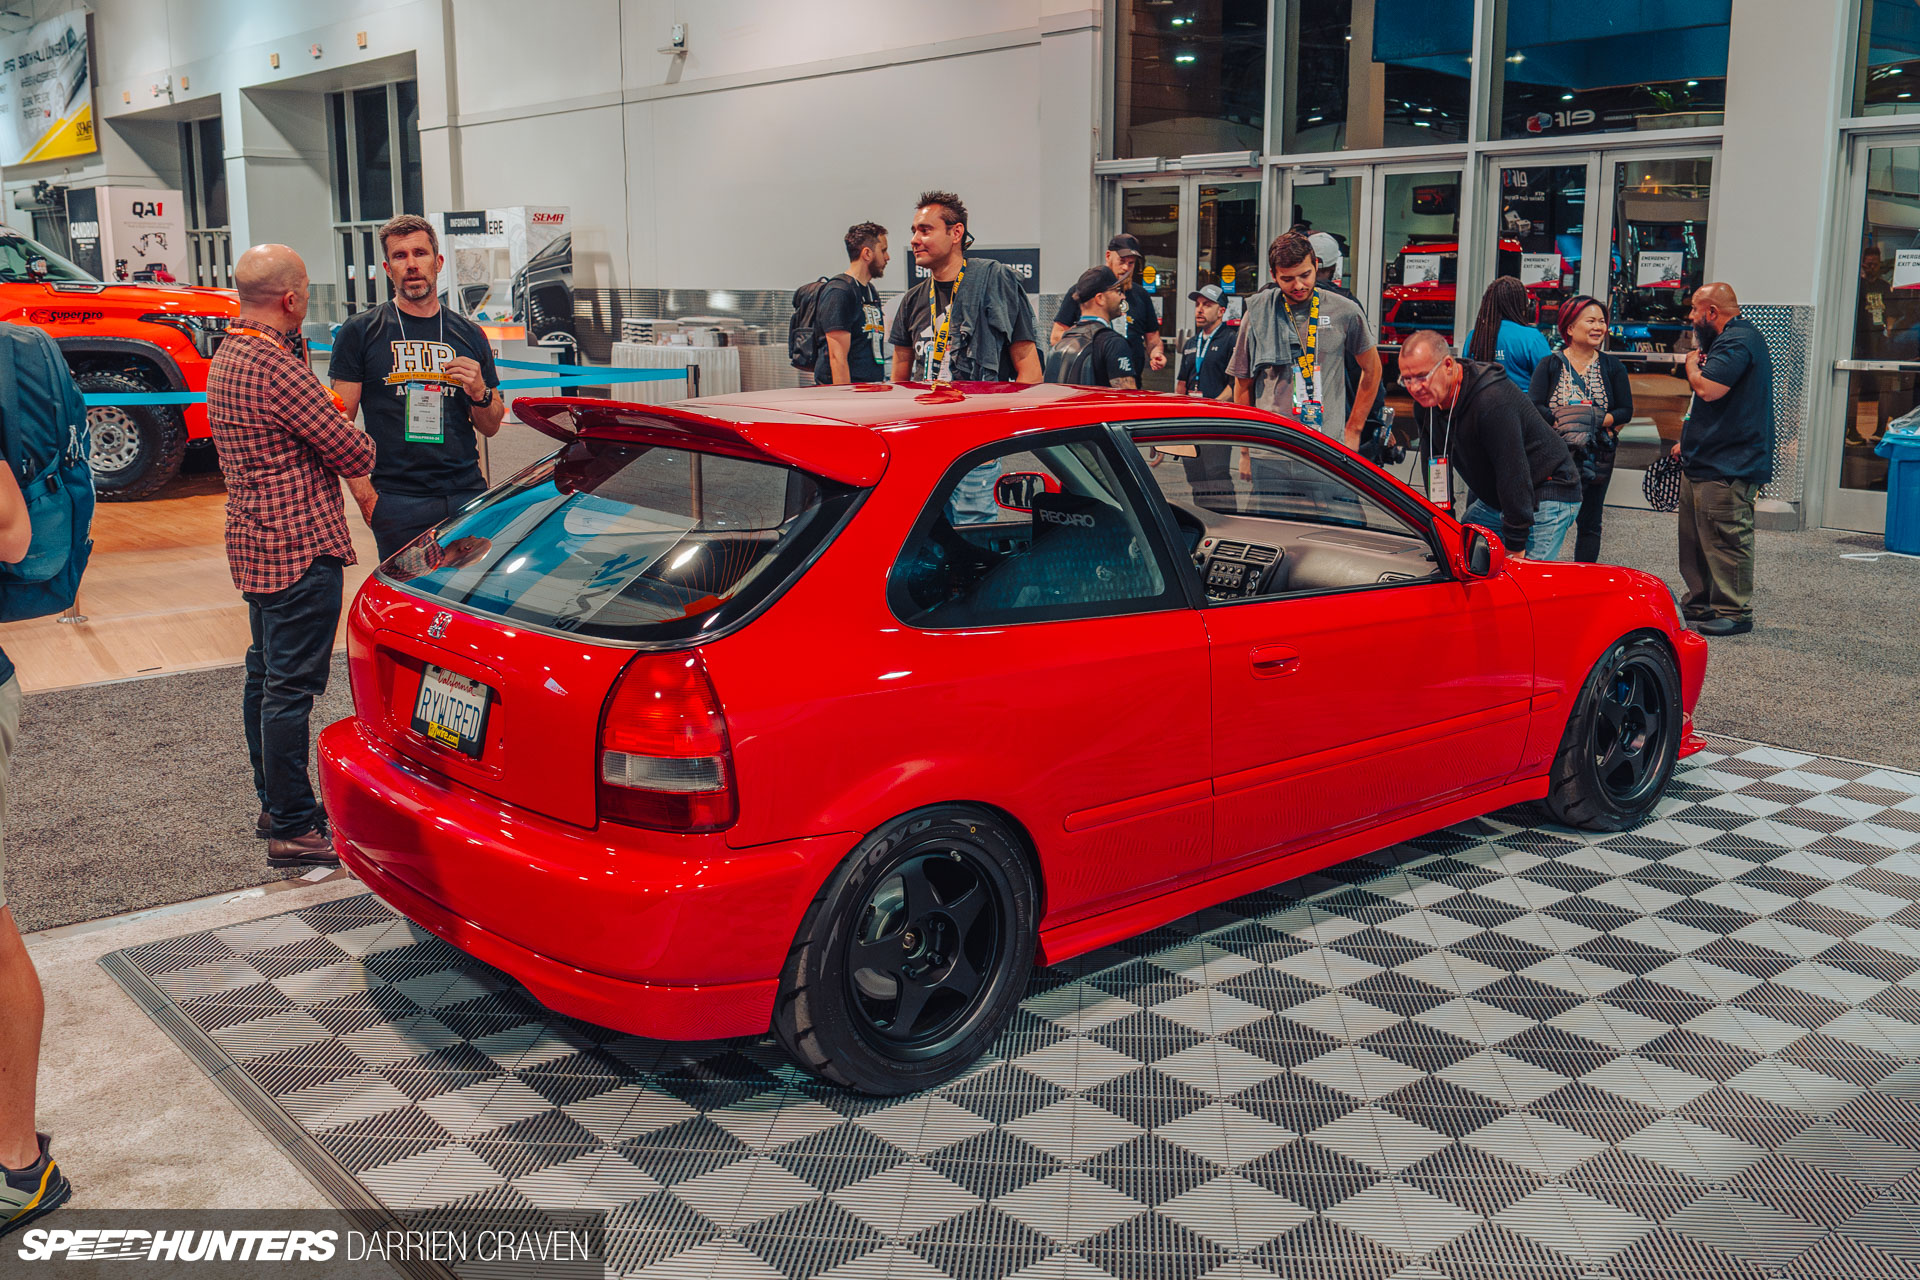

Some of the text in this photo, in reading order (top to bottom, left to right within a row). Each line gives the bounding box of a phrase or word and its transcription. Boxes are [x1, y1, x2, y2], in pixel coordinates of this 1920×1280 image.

[132, 201, 163, 218] QA1
[532, 213, 564, 222] SEMA
[449, 217, 480, 228] INFORMATION
[935, 330, 948, 353] WD-40
[391, 340, 456, 373] HP
[1039, 509, 1096, 528] RECARO
[437, 669, 476, 697] California
[420, 687, 481, 741] RYWIRED
[850, 819, 932, 888] TOYO
